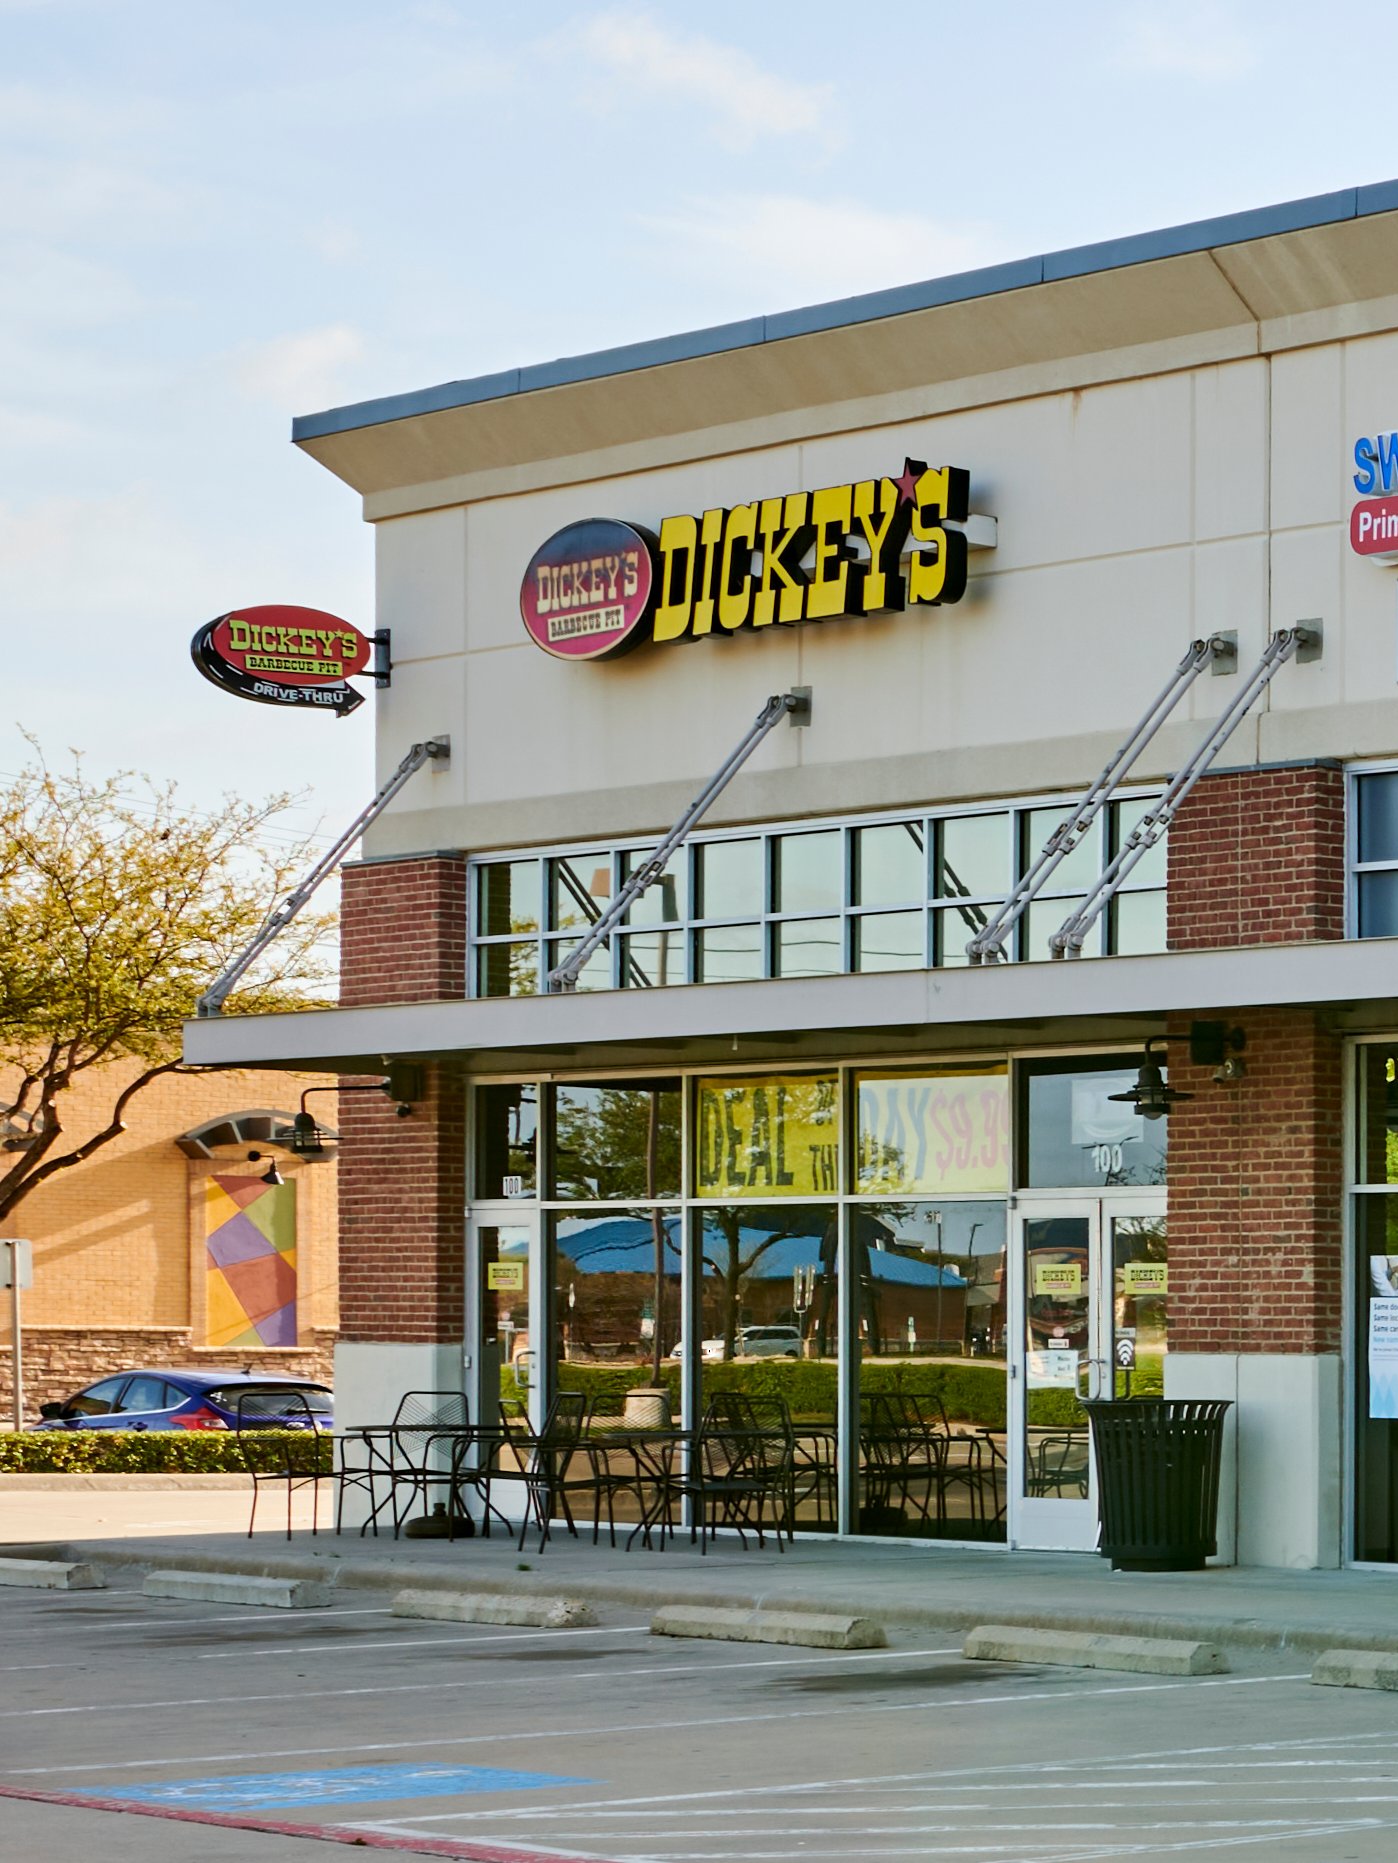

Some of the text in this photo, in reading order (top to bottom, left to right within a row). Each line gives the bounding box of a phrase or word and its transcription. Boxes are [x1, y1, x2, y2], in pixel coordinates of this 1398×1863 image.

[652, 464, 958, 643] DICKEY'S
[536, 551, 640, 615] DICKEY'S
[549, 607, 622, 638] BARBECUE PIT
[228, 619, 359, 659] DICKEY'S
[248, 656, 340, 675] BARBECUE PIT
[253, 682, 344, 704] DRIVE-THRU
[699, 1087, 795, 1187] DEAL
[1091, 1144, 1123, 1173] 100
[504, 1178, 519, 1195] 100
